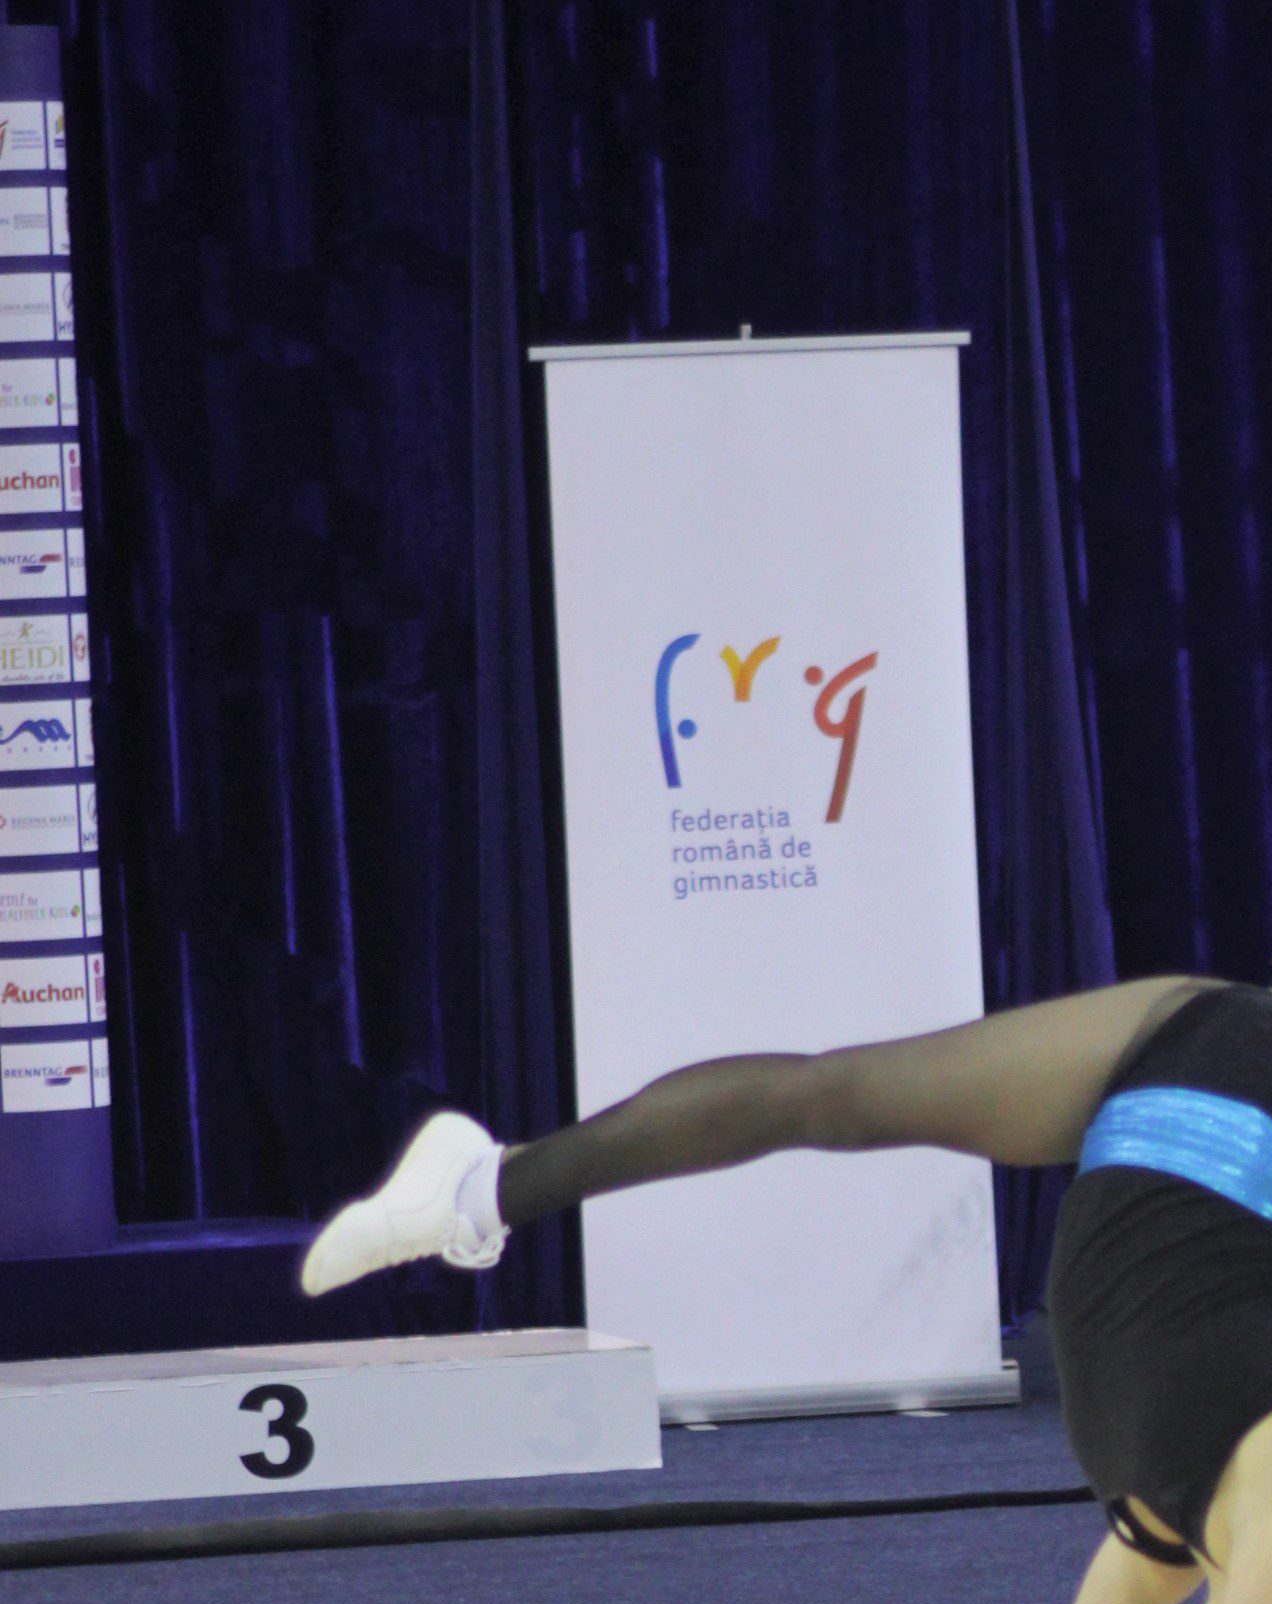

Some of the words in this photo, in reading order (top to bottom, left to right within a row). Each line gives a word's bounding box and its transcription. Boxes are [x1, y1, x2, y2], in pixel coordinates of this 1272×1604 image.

[0, 471, 59, 491] uchan
[670, 806, 791, 833] federația
[672, 838, 772, 864] română
[780, 836, 812, 858] de
[673, 865, 818, 899] gimnastică
[1, 982, 85, 1004] Auchan
[238, 1383, 315, 1480] 3
